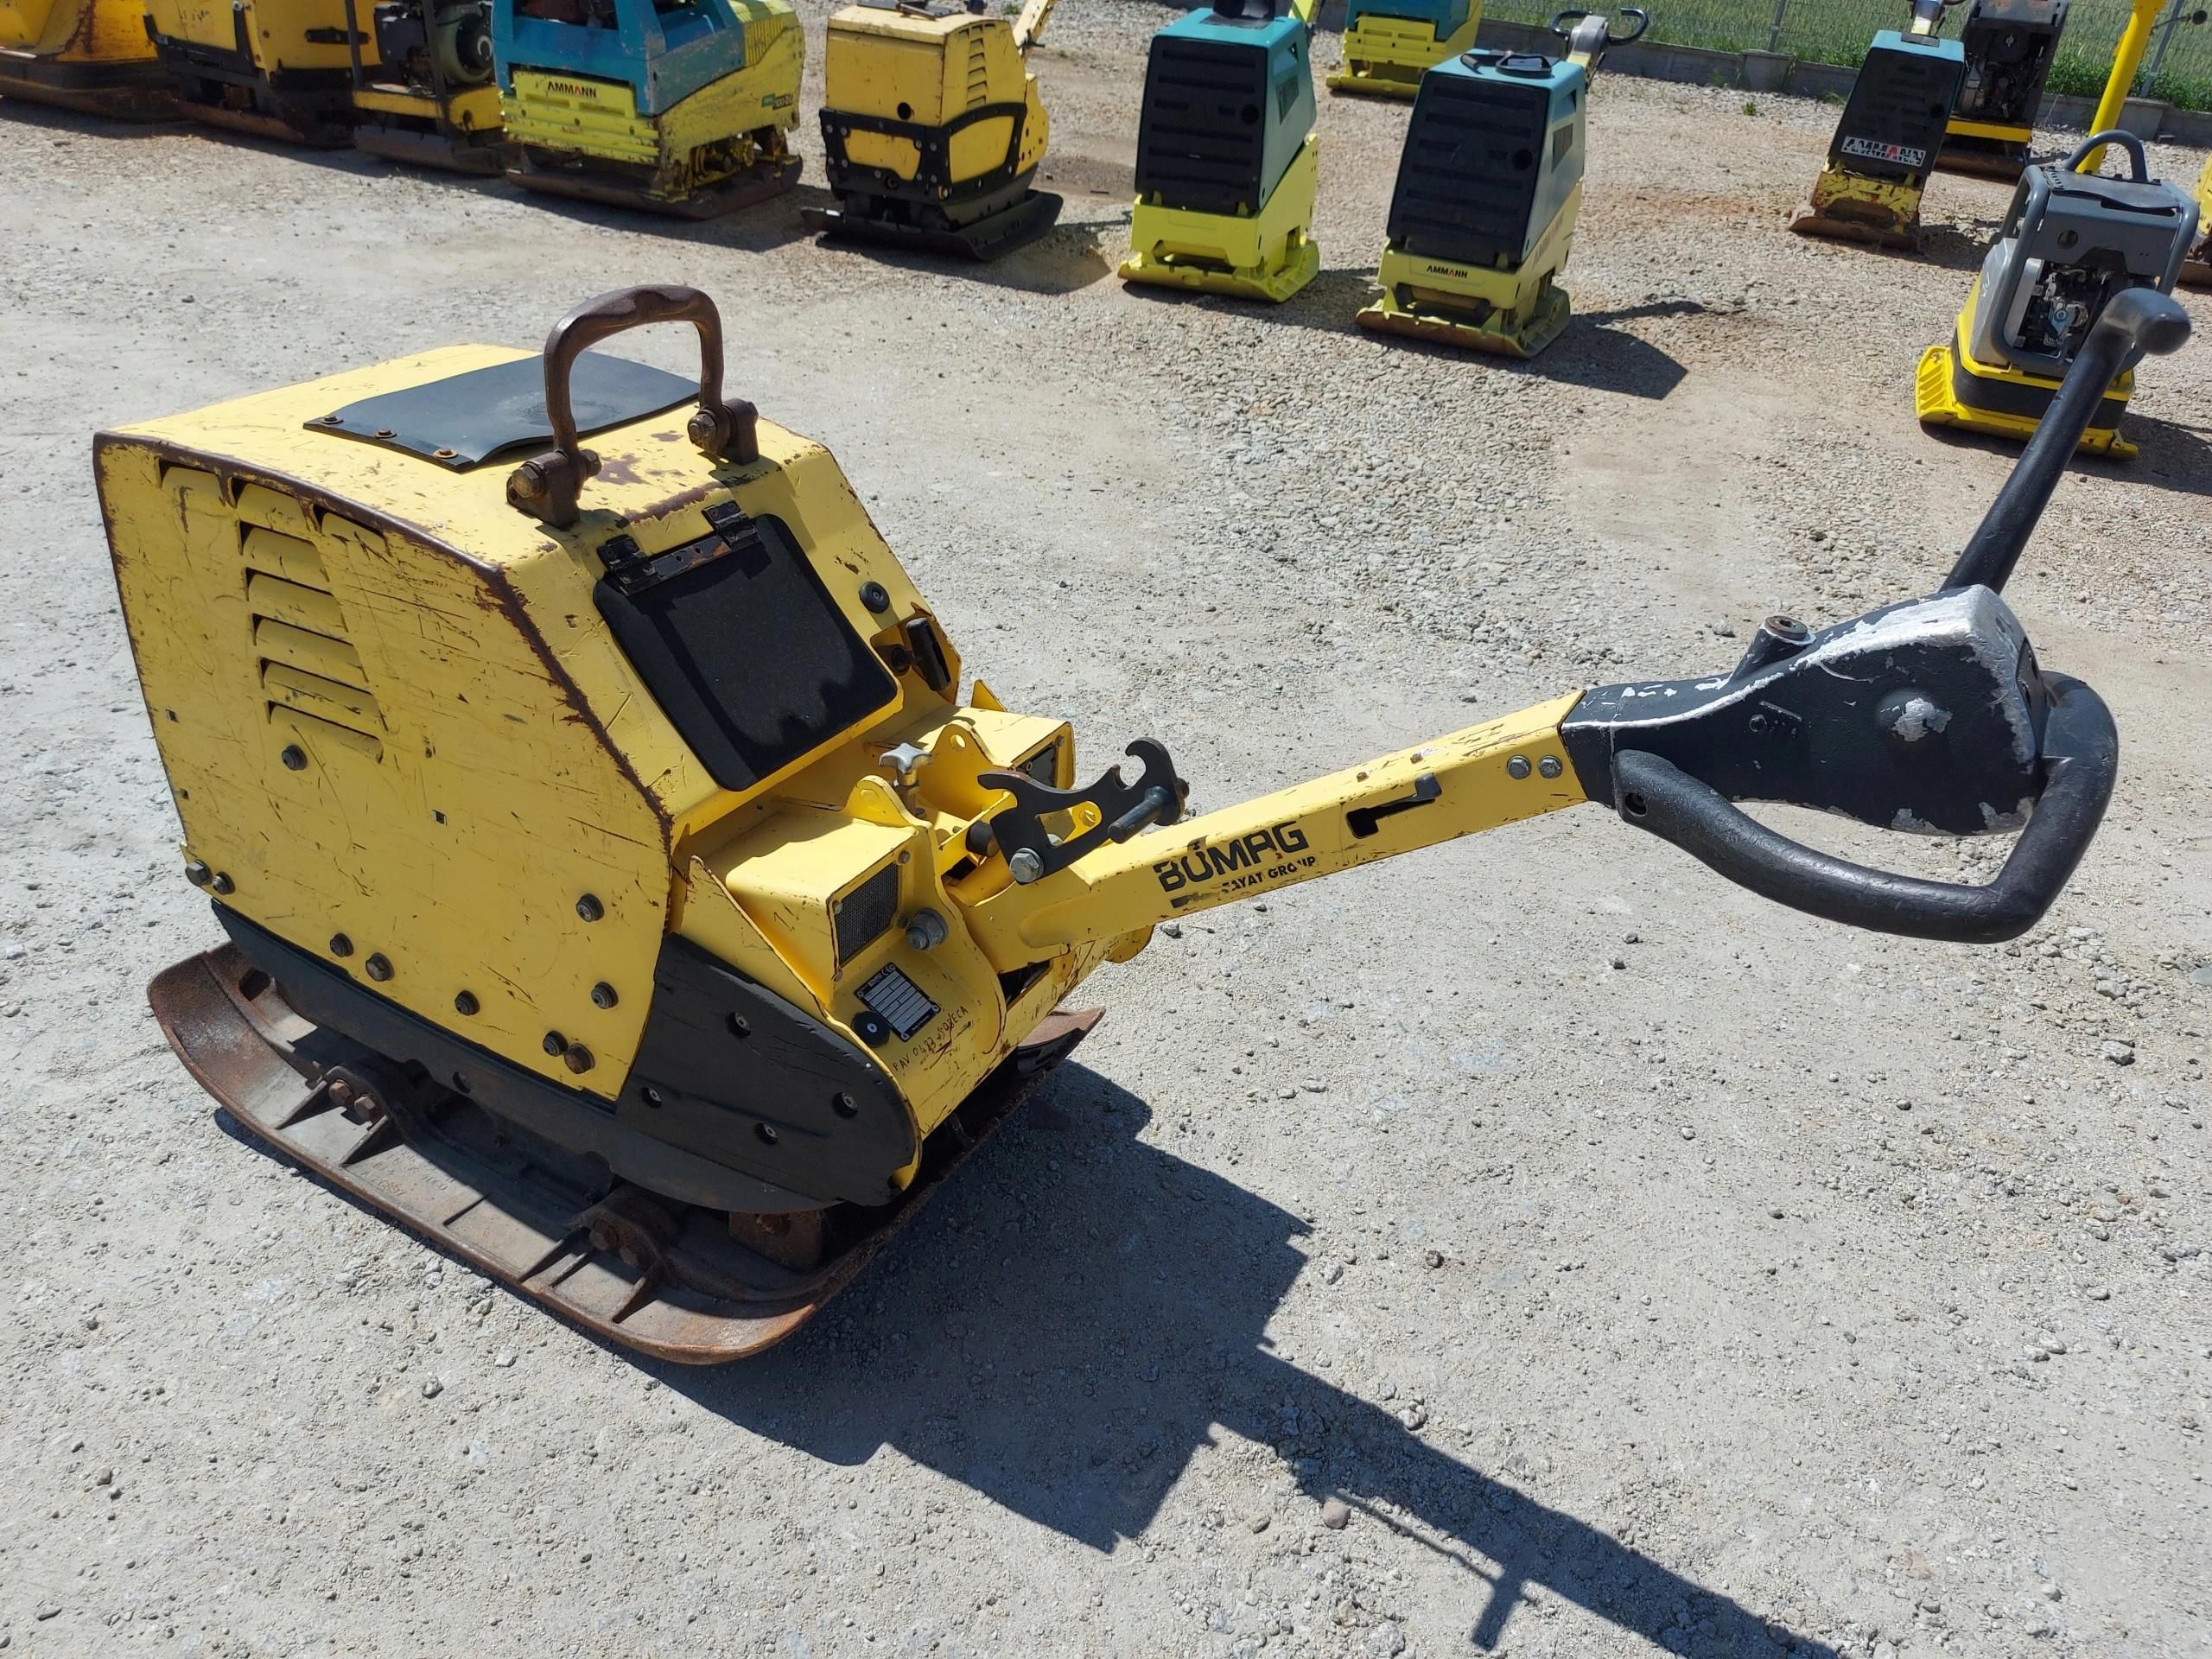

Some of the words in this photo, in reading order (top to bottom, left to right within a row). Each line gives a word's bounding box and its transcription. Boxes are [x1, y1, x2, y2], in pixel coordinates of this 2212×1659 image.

[547, 81, 597, 98] AMMANN
[1427, 264, 1468, 279] AMMANN
[1152, 820, 1310, 893] BOMAG
[893, 1054, 910, 1071] PAV
